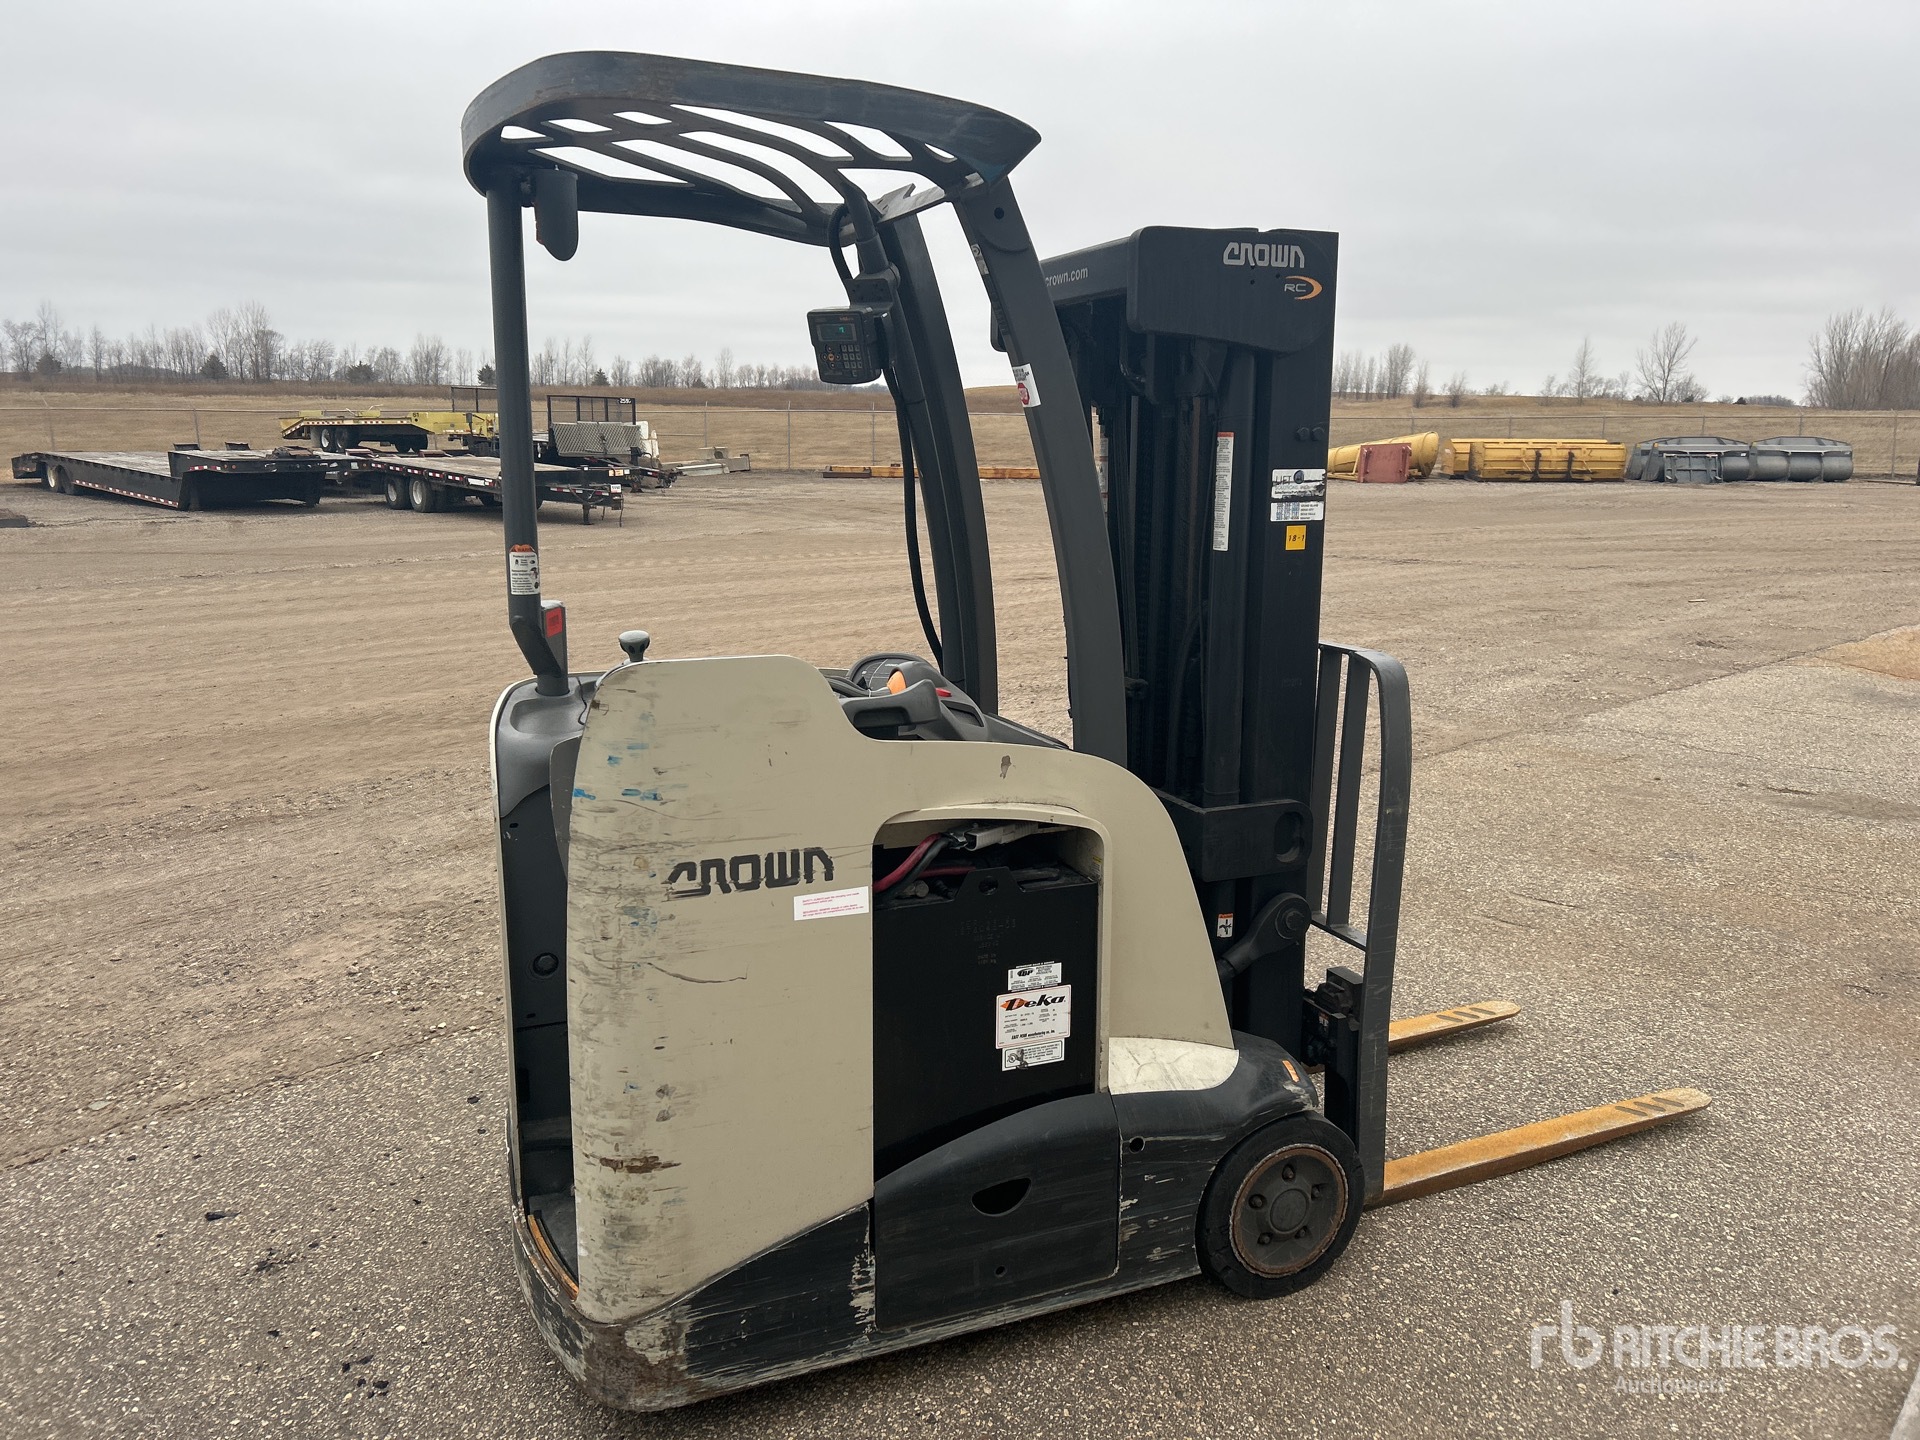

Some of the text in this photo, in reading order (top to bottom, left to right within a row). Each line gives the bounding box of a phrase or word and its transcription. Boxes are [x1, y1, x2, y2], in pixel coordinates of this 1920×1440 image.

[1222, 241, 1305, 268] CROWN
[1284, 283, 1307, 293] RC
[664, 846, 834, 899] CROWN
[1004, 994, 1066, 1011] Deka
